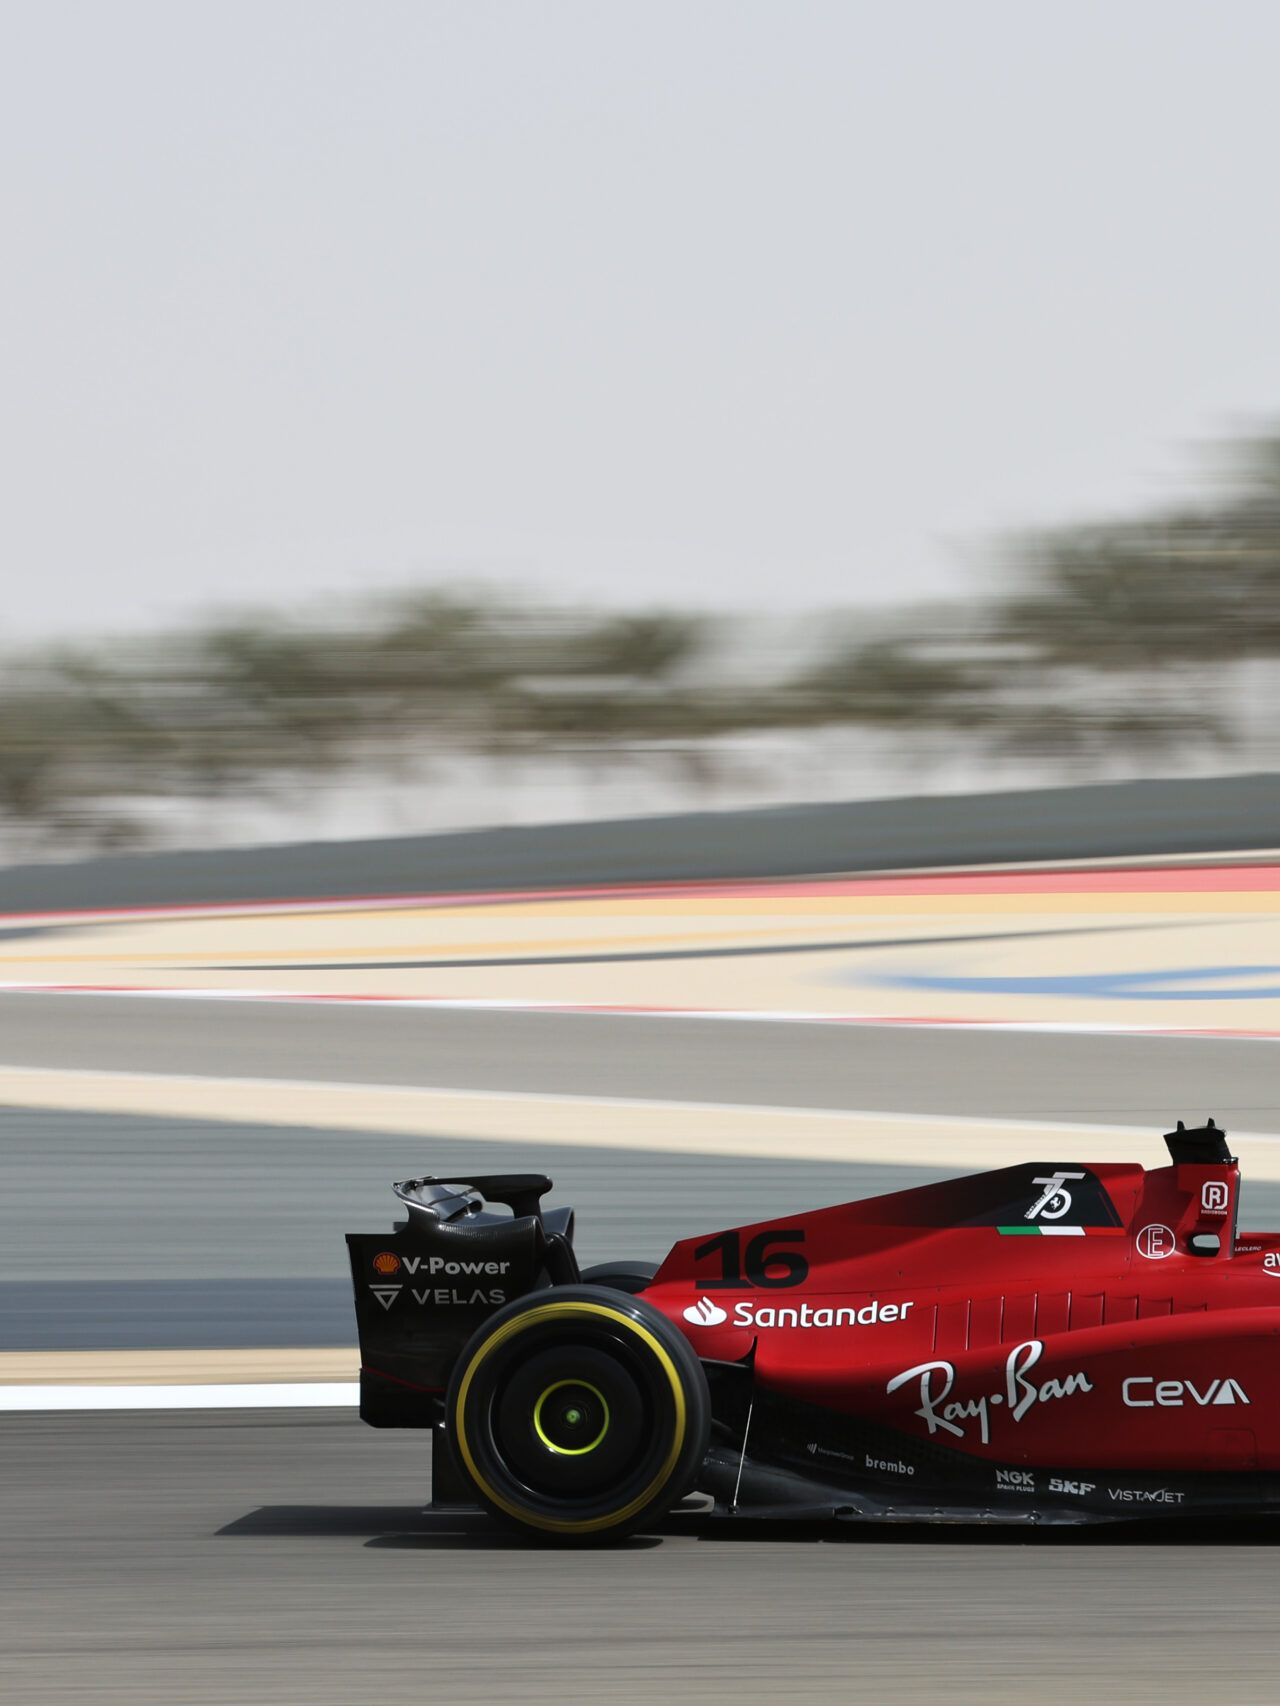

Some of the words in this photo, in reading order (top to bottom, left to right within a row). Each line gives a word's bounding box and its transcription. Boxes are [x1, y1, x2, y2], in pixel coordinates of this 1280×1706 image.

[401, 1256, 510, 1275] V-Power
[694, 1229, 809, 1290] 16
[411, 1288, 506, 1305] VELAS
[733, 1300, 914, 1328] Santander
[865, 1454, 915, 1475] brembo
[995, 1469, 1035, 1486] NGK
[1048, 1478, 1096, 1496] SKF
